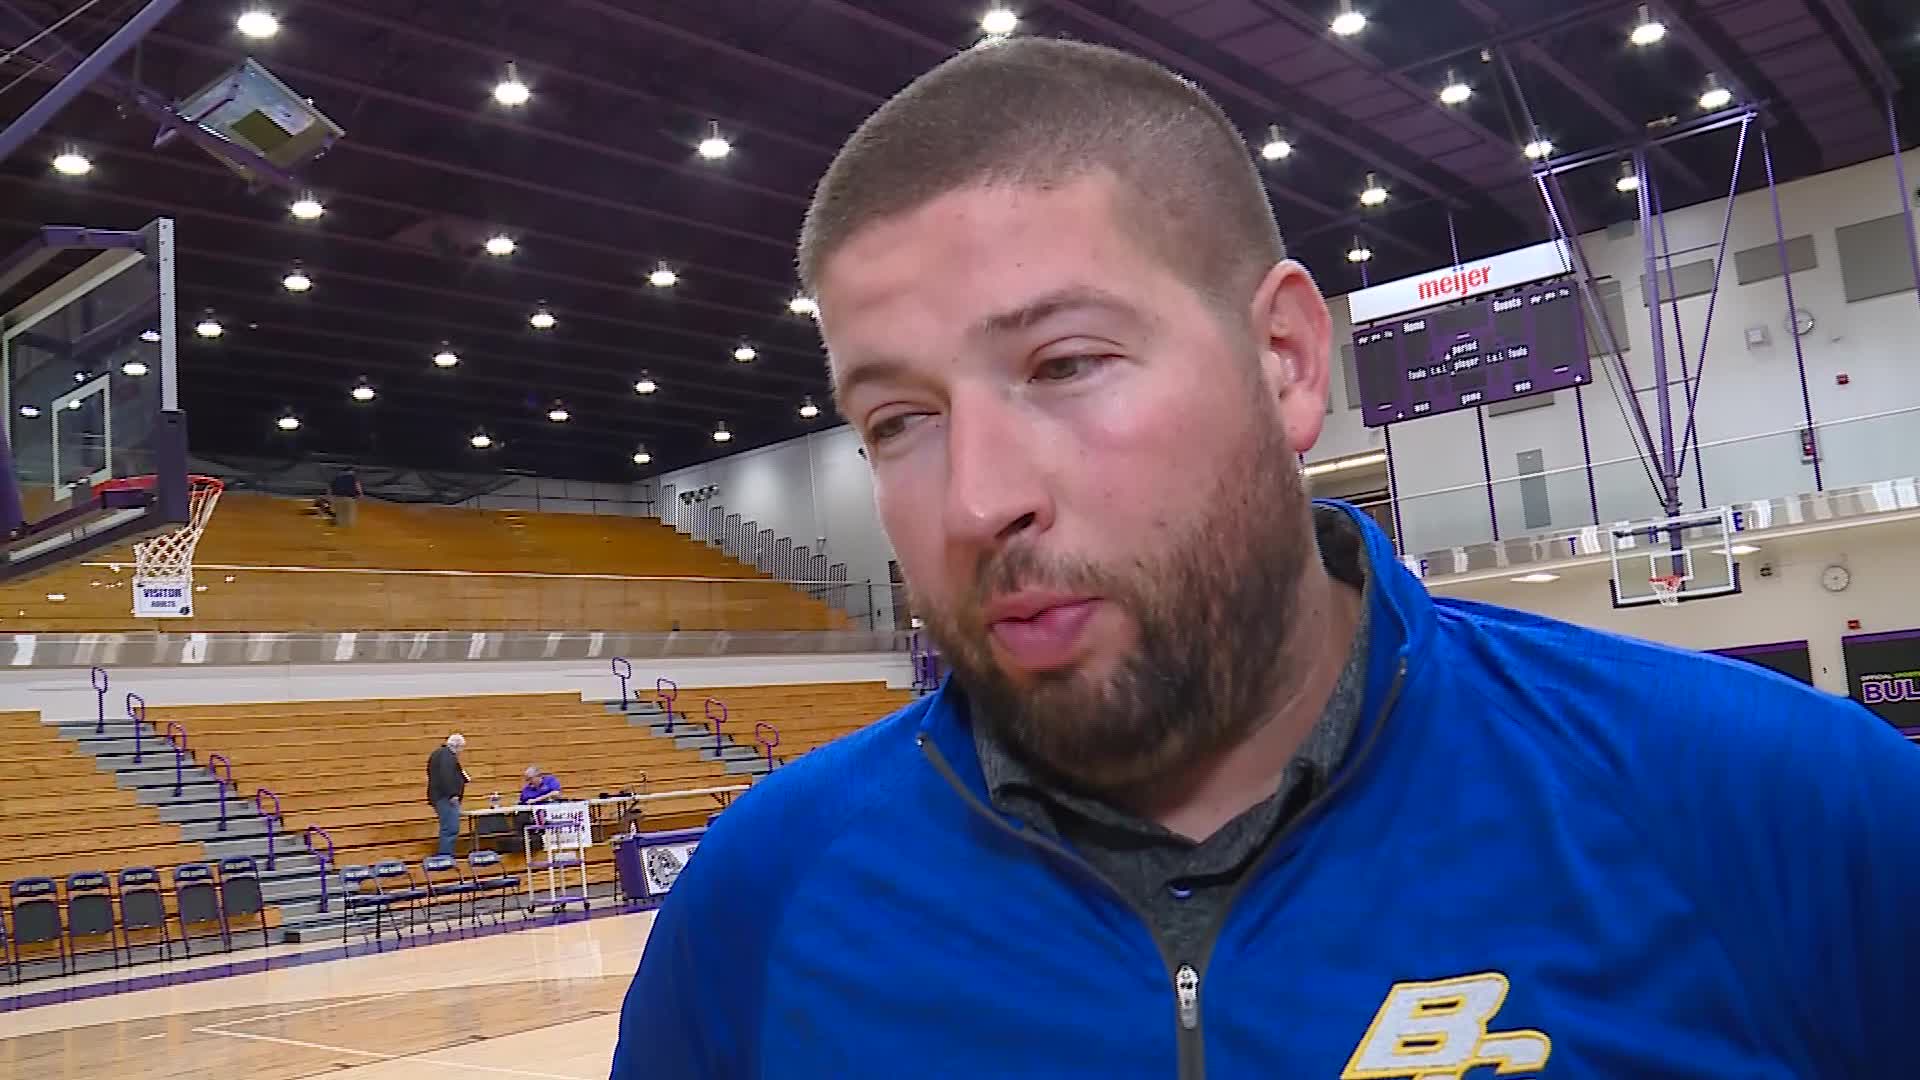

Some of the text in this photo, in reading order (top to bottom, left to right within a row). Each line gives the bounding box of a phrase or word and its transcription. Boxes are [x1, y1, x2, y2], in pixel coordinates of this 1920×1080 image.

[1417, 264, 1492, 301] meijer
[1402, 319, 1426, 334] Home
[1451, 339, 1479, 357] period
[1453, 356, 1481, 372] player
[142, 588, 183, 598] VISITOR
[1862, 678, 1920, 704] BUL
